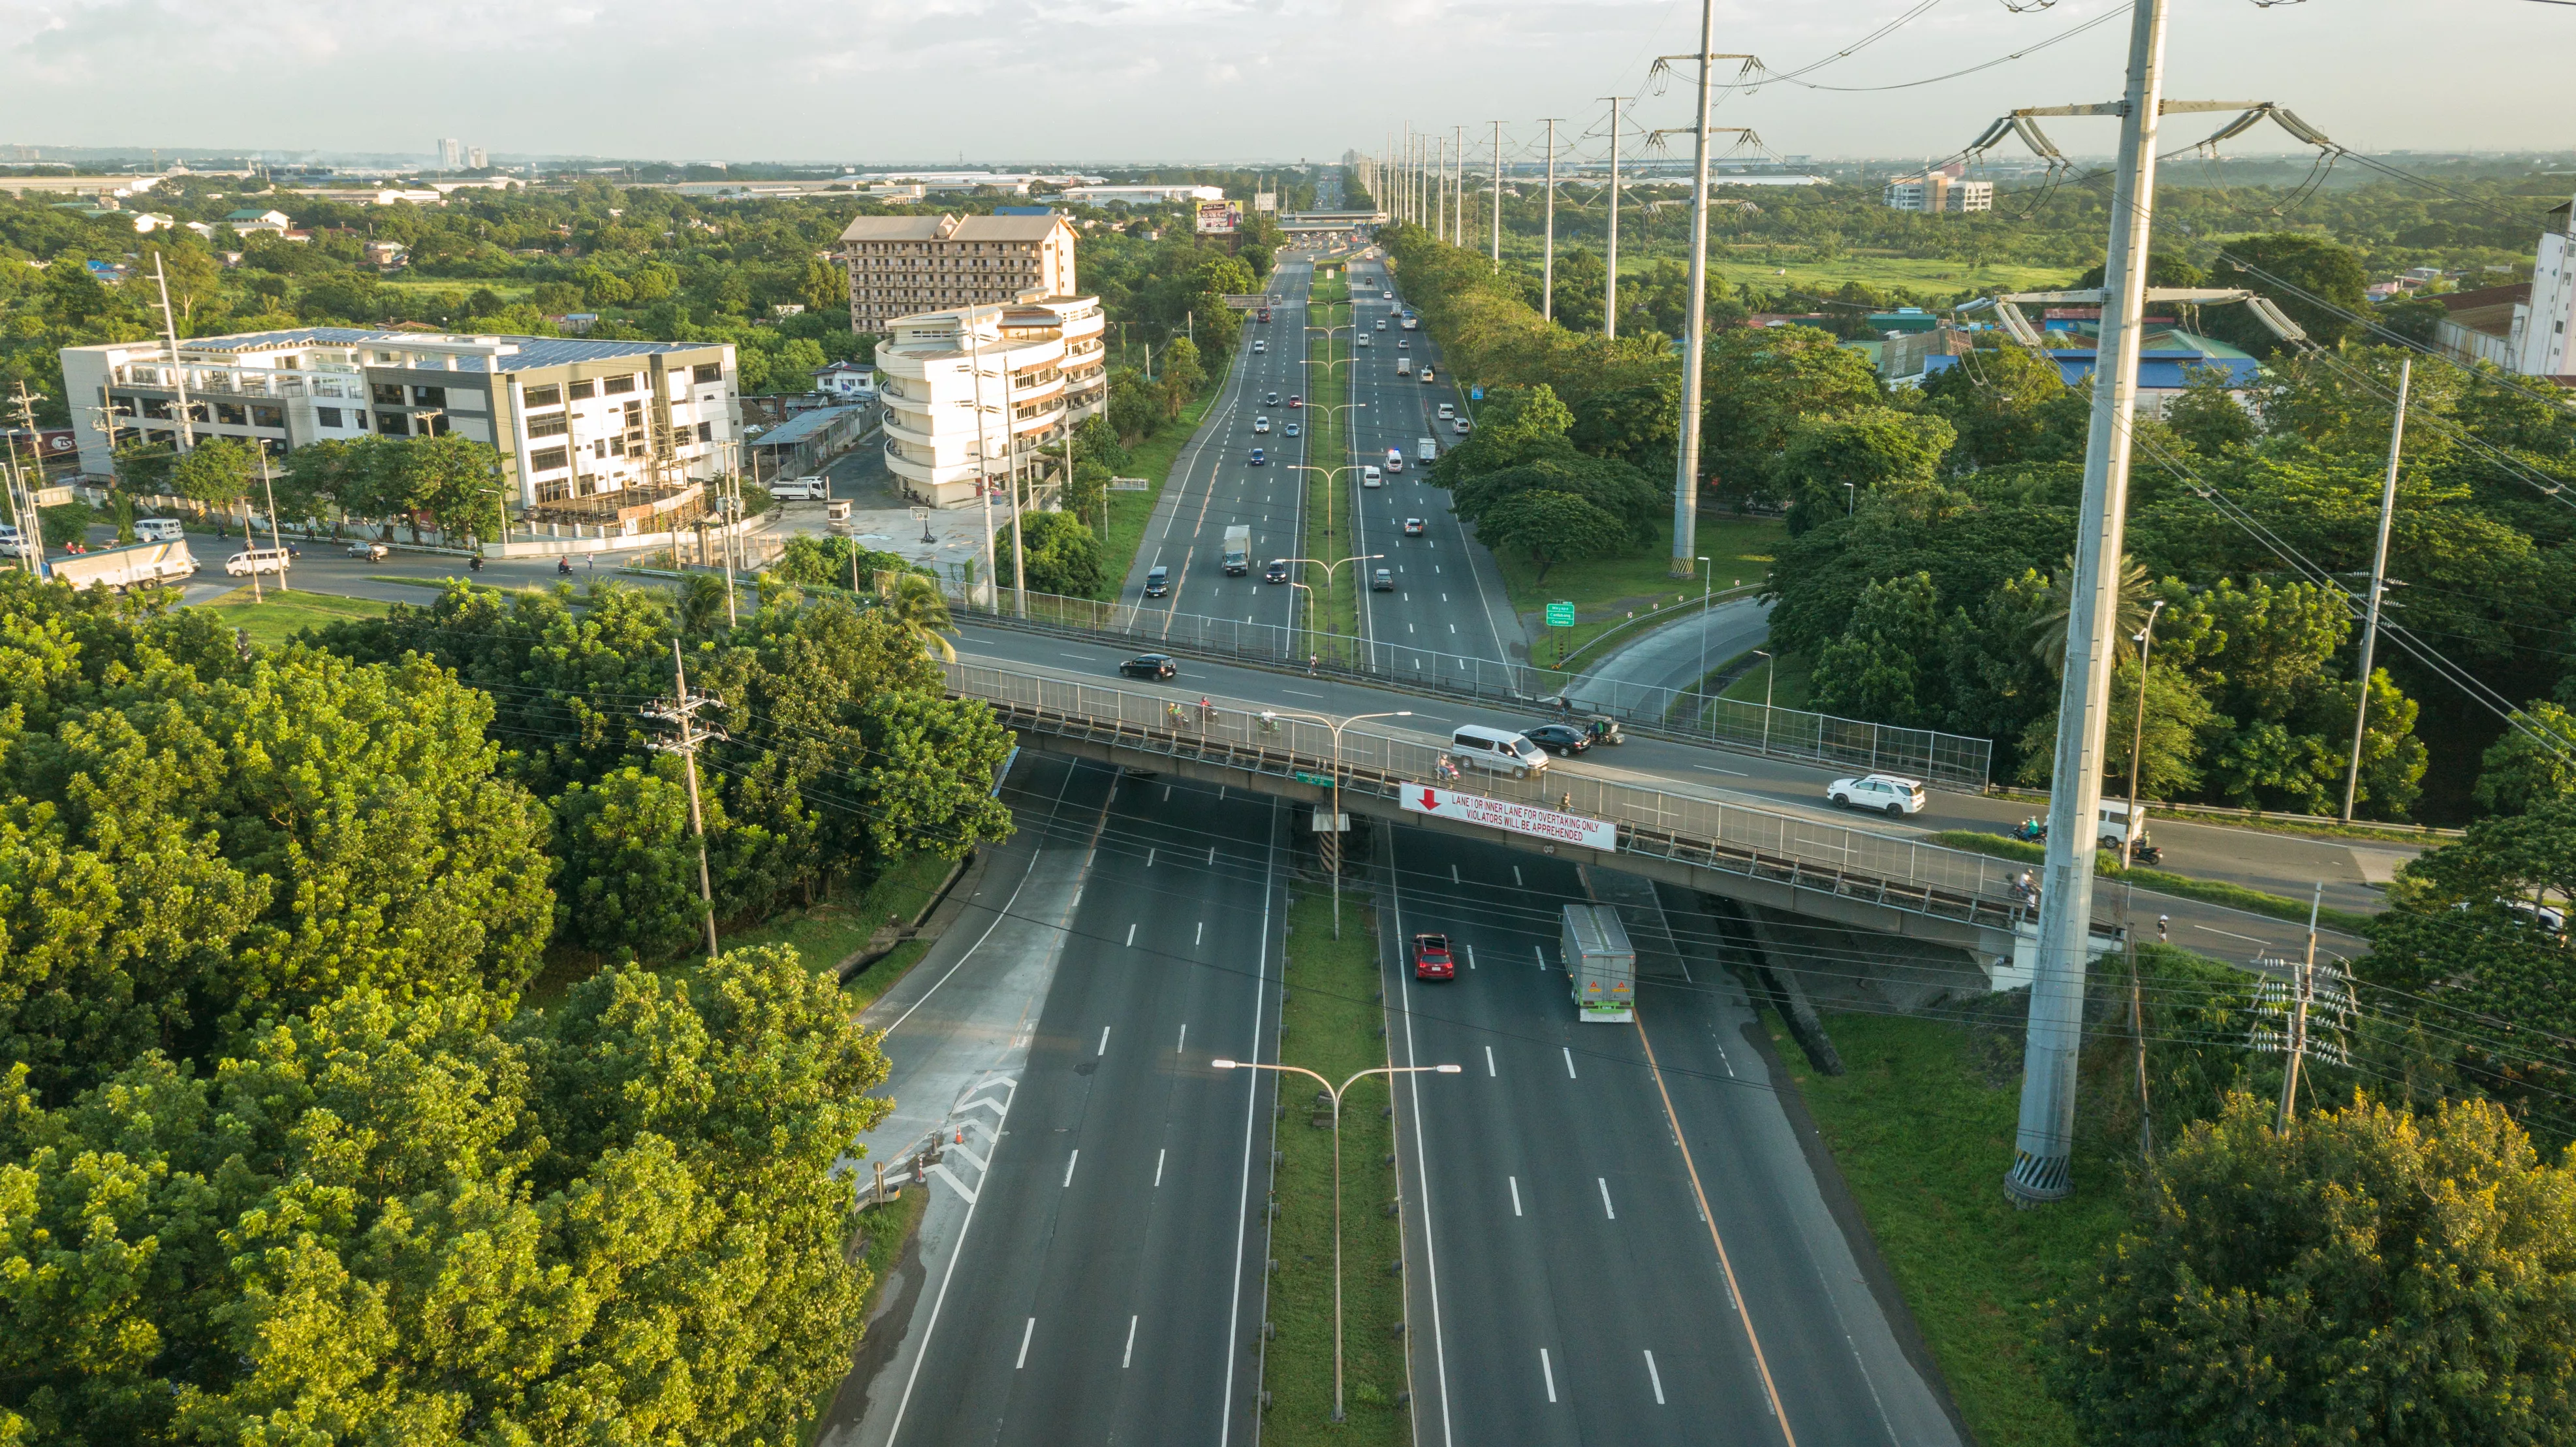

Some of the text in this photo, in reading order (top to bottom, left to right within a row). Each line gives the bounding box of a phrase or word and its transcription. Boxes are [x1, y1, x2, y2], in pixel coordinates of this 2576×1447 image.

[1452, 794, 1470, 807] LANE
[1474, 800, 1483, 809] OR
[1484, 801, 1503, 814] INNER
[1504, 804, 1522, 818] LANE
[1524, 809, 1537, 821] FOR
[1538, 812, 1580, 829] OVERTAKING
[1582, 820, 1599, 833] ONLY
[1466, 808, 1583, 842] VIOLATORS WILL BE APPREHENDED
